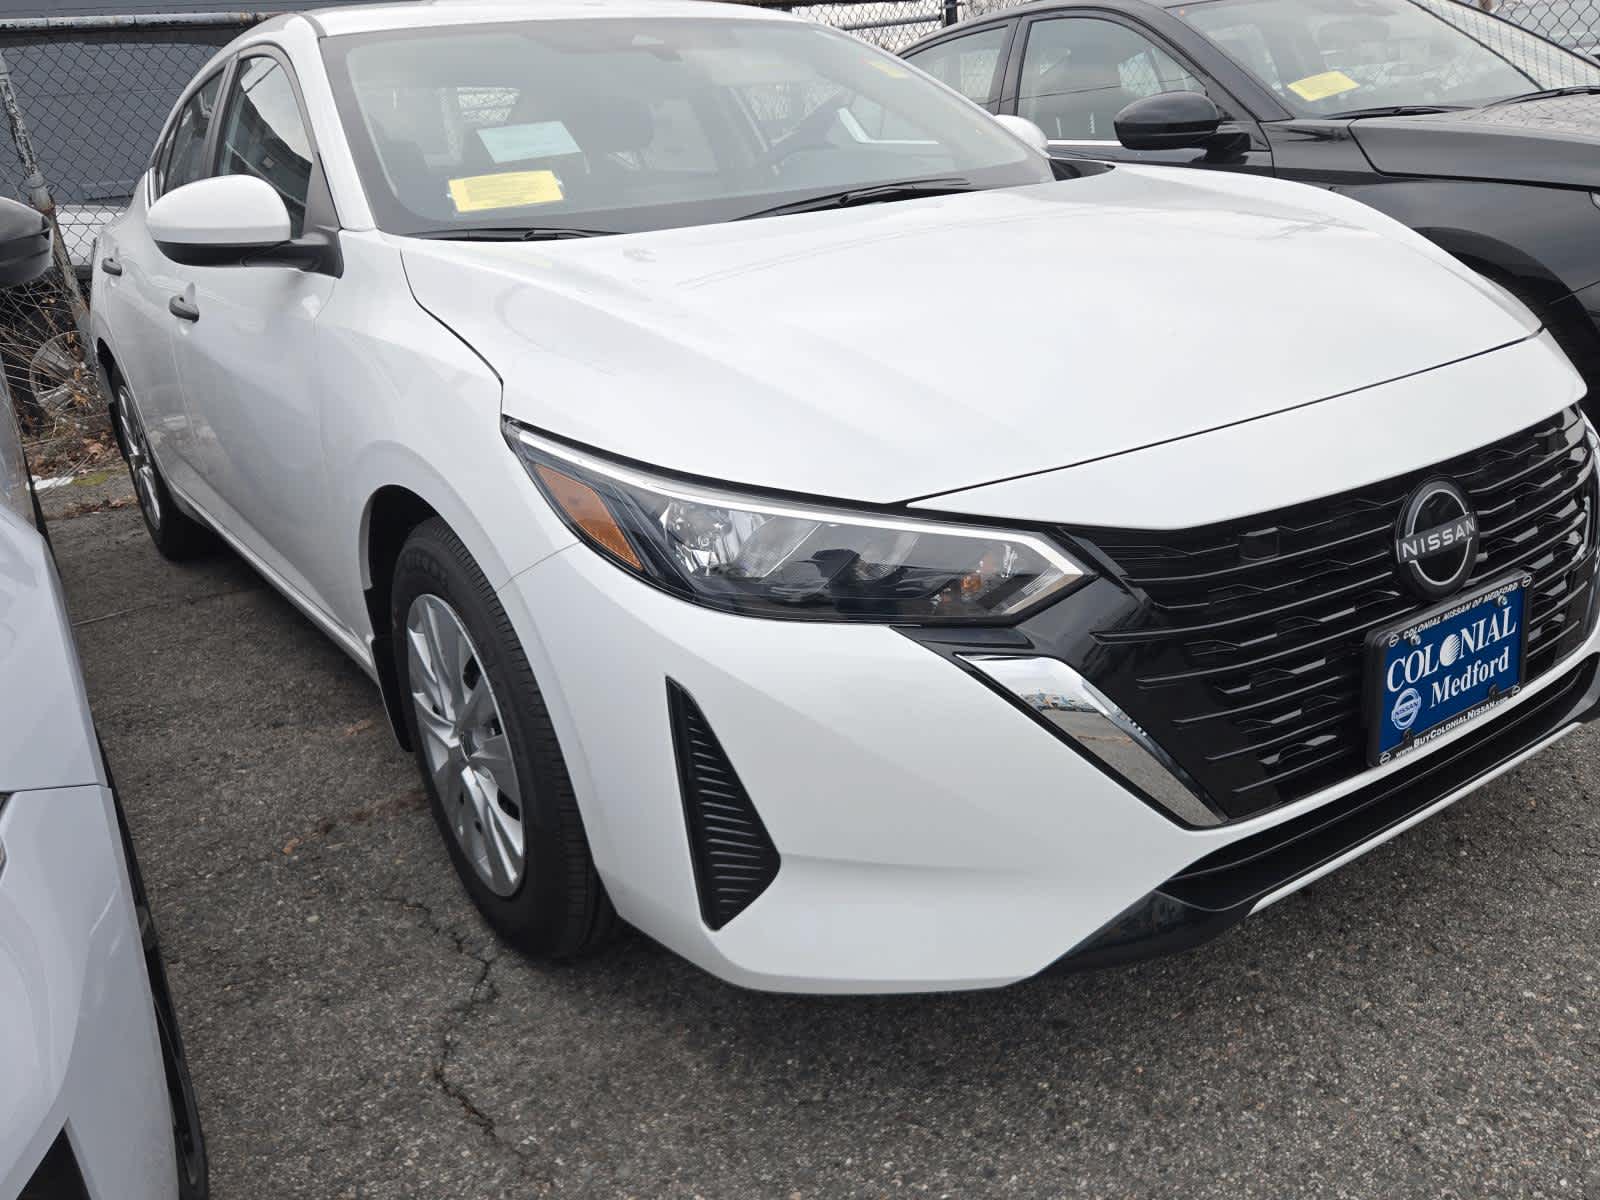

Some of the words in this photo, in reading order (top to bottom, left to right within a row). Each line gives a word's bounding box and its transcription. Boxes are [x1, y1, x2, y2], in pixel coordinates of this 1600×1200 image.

[1402, 517, 1475, 558] NISSAN
[1403, 616, 1441, 640] COLONIAL
[1441, 602, 1472, 622] NISSAN
[1471, 597, 1483, 609] OF
[1483, 582, 1518, 603] MEDFORD
[1387, 606, 1517, 693] COLONIAL
[1430, 647, 1509, 708] Medford
[1395, 701, 1418, 717] NISSAN
